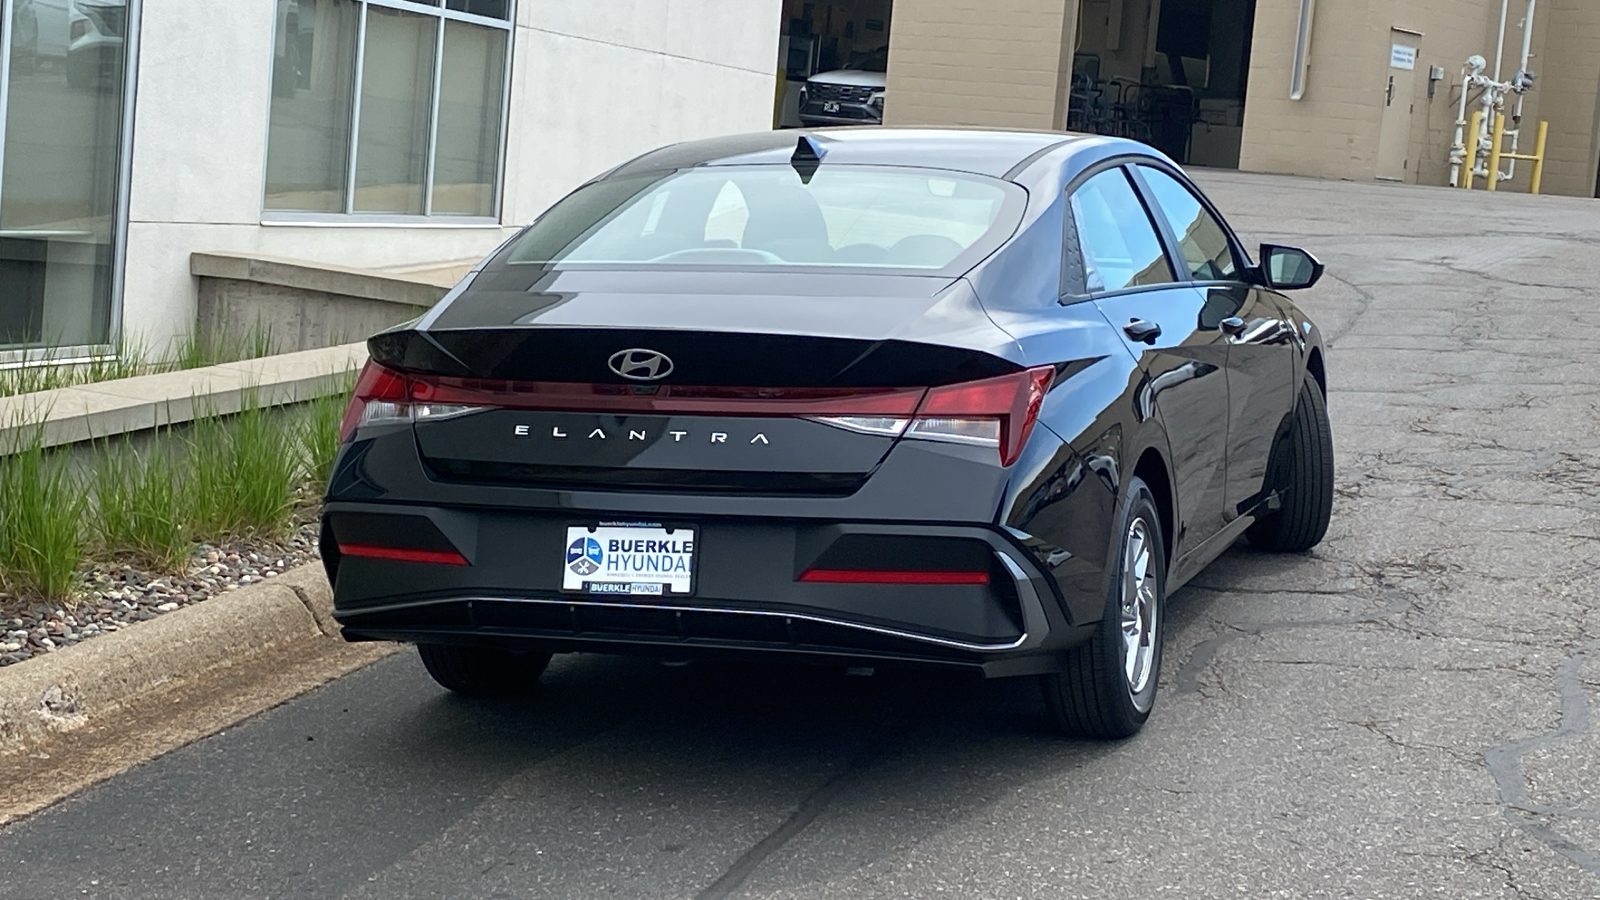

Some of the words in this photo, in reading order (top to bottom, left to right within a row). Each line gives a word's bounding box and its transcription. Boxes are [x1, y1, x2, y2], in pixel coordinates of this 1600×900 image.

[514, 424, 769, 445] ELANTRA
[608, 539, 693, 554] BUERKLE
[607, 554, 692, 572] HYUNDAI
[591, 583, 631, 592] BUERKLE
[632, 584, 661, 593] HYUNDAI
